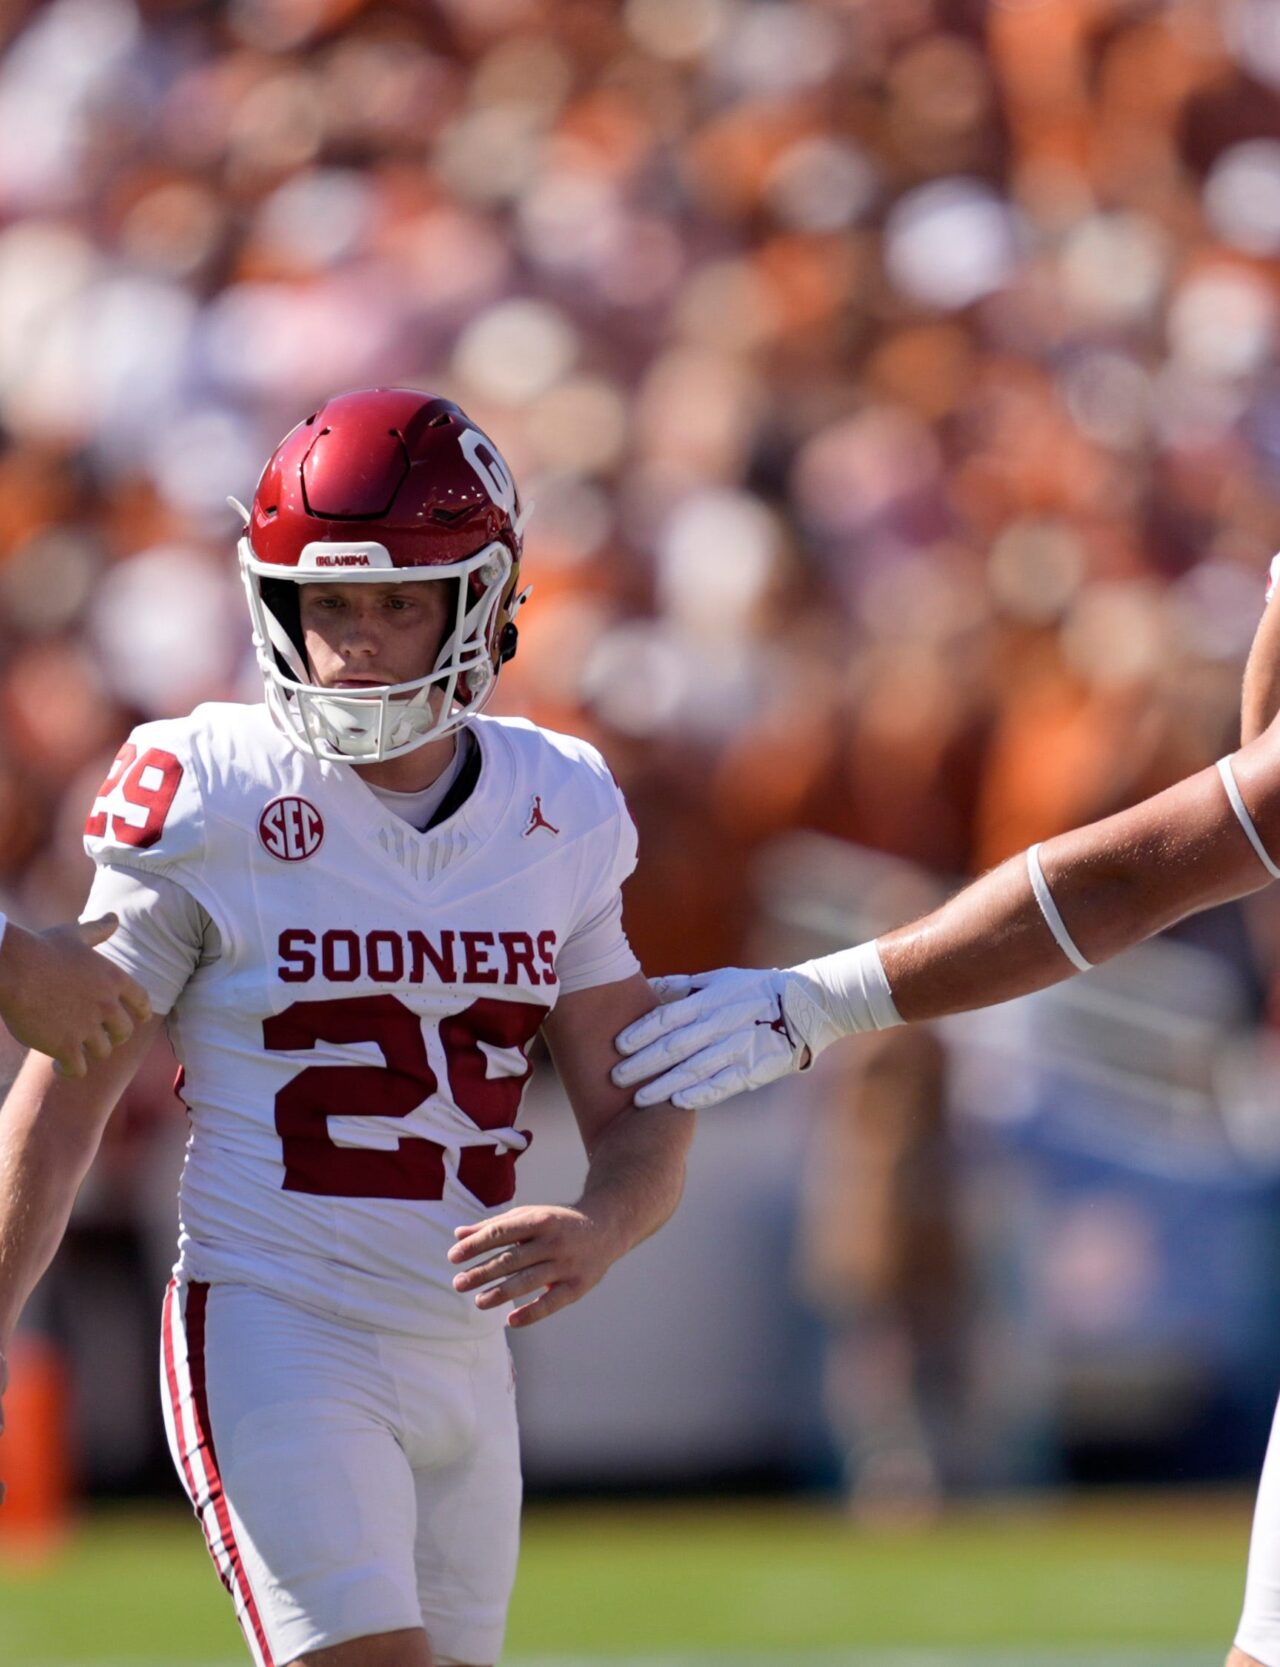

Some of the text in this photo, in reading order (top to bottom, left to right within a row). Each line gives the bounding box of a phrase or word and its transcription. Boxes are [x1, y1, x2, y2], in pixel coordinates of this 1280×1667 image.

[315, 554, 370, 568] OKLAHOMA
[84, 743, 184, 849] 29
[263, 799, 321, 858] SEC
[278, 929, 557, 985] SOONERS
[263, 994, 551, 1208] 29
